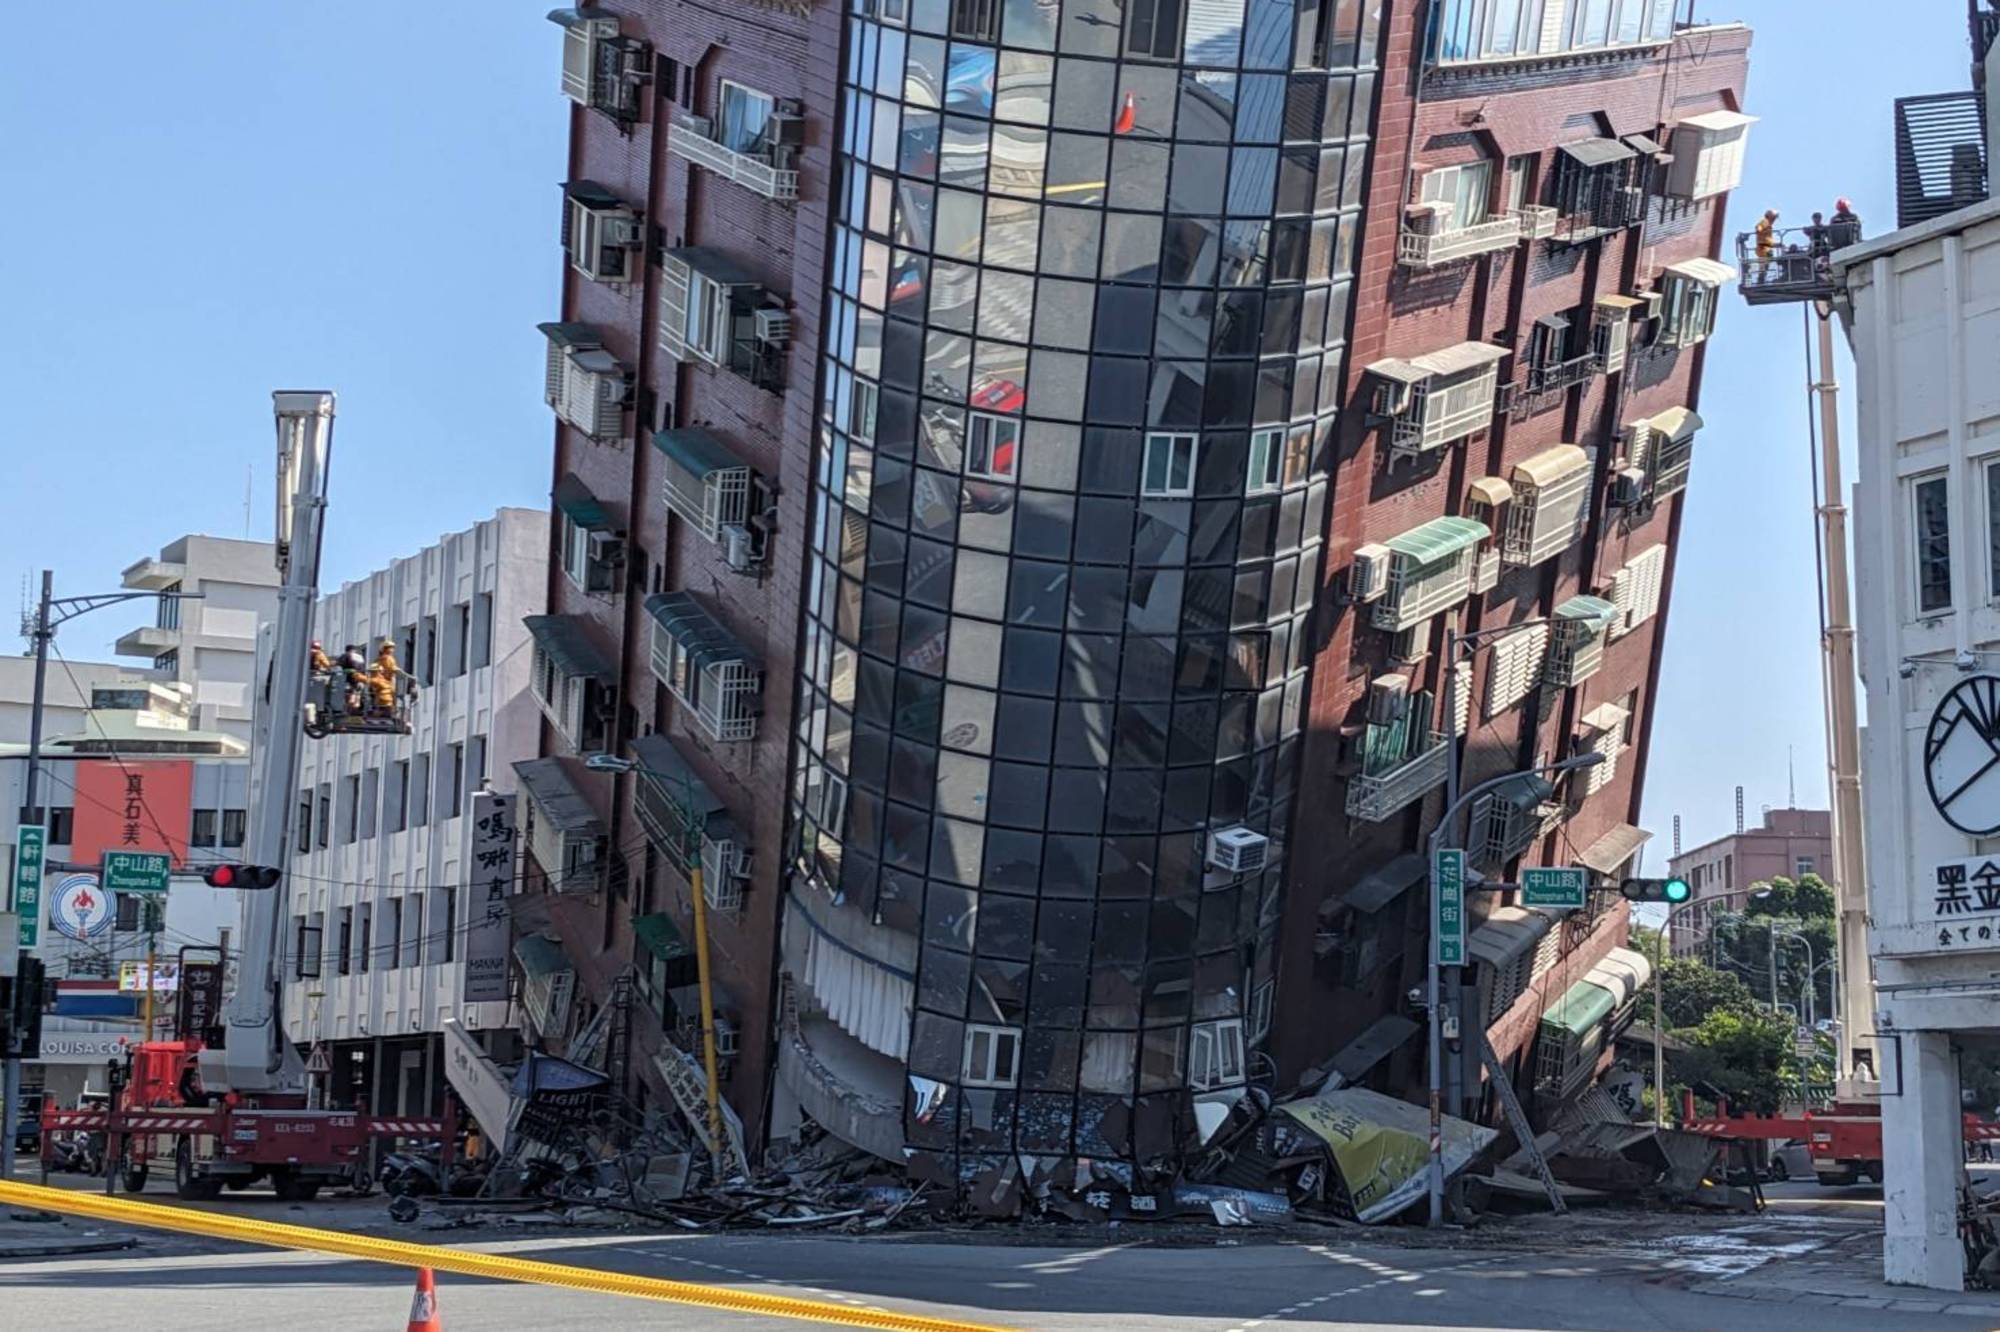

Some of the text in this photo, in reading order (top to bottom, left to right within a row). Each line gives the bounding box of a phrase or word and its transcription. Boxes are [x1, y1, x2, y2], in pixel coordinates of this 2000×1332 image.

[122, 774, 144, 845] 真石美
[114, 855, 164, 872] 中山路
[1530, 872, 1576, 888] 中山路
[1939, 926, 2000, 946] 全ての
[40, 1042, 94, 1054] LOUISA
[539, 1092, 588, 1106] LIGHT
